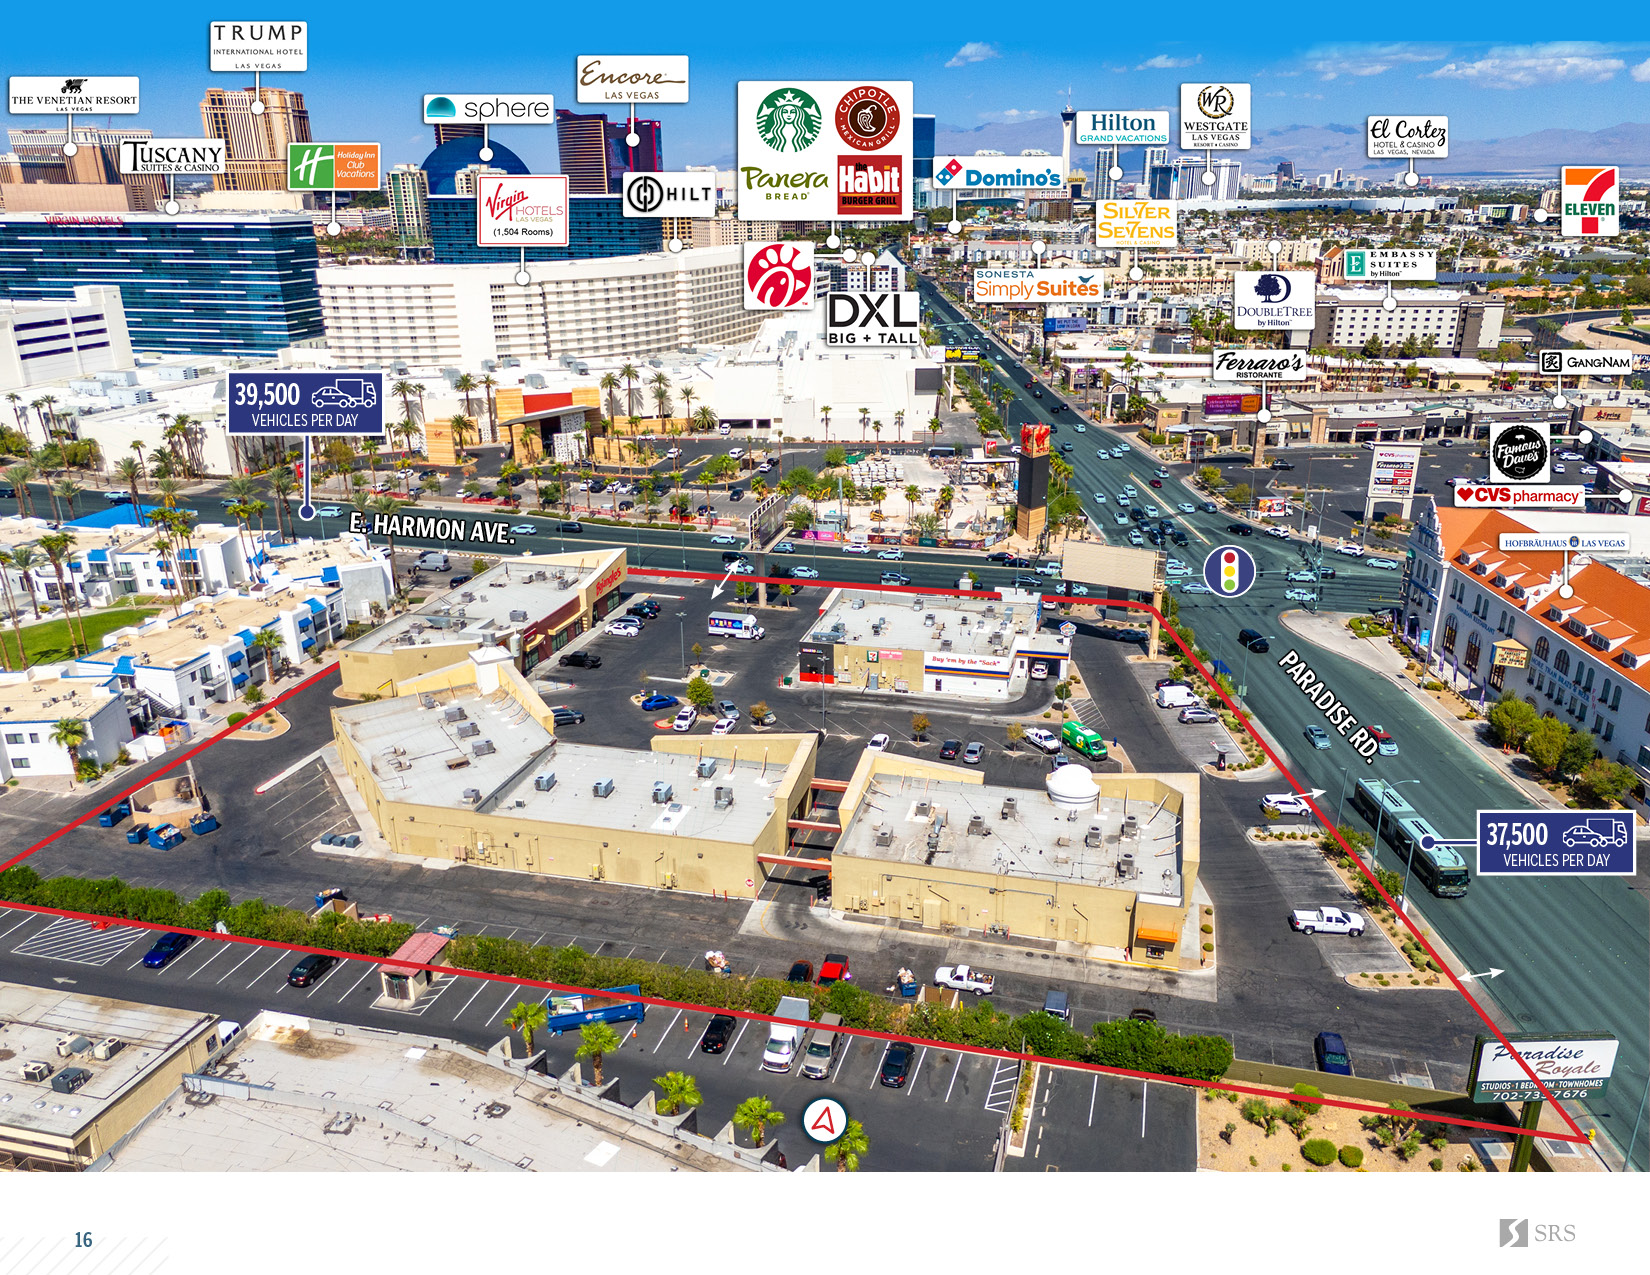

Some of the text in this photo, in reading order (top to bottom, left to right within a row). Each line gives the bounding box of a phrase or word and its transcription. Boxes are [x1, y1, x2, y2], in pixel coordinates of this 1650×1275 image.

[44, 216, 124, 224] VIRGIN HOTELS
[1531, 656, 1544, 670] MORE
[1535, 1060, 1600, 1077] Royale
[1481, 1082, 1511, 1090] STUDIOS
[1520, 1080, 1555, 1089] BEDROM
[1559, 1079, 1603, 1088] TOWNHOMES
